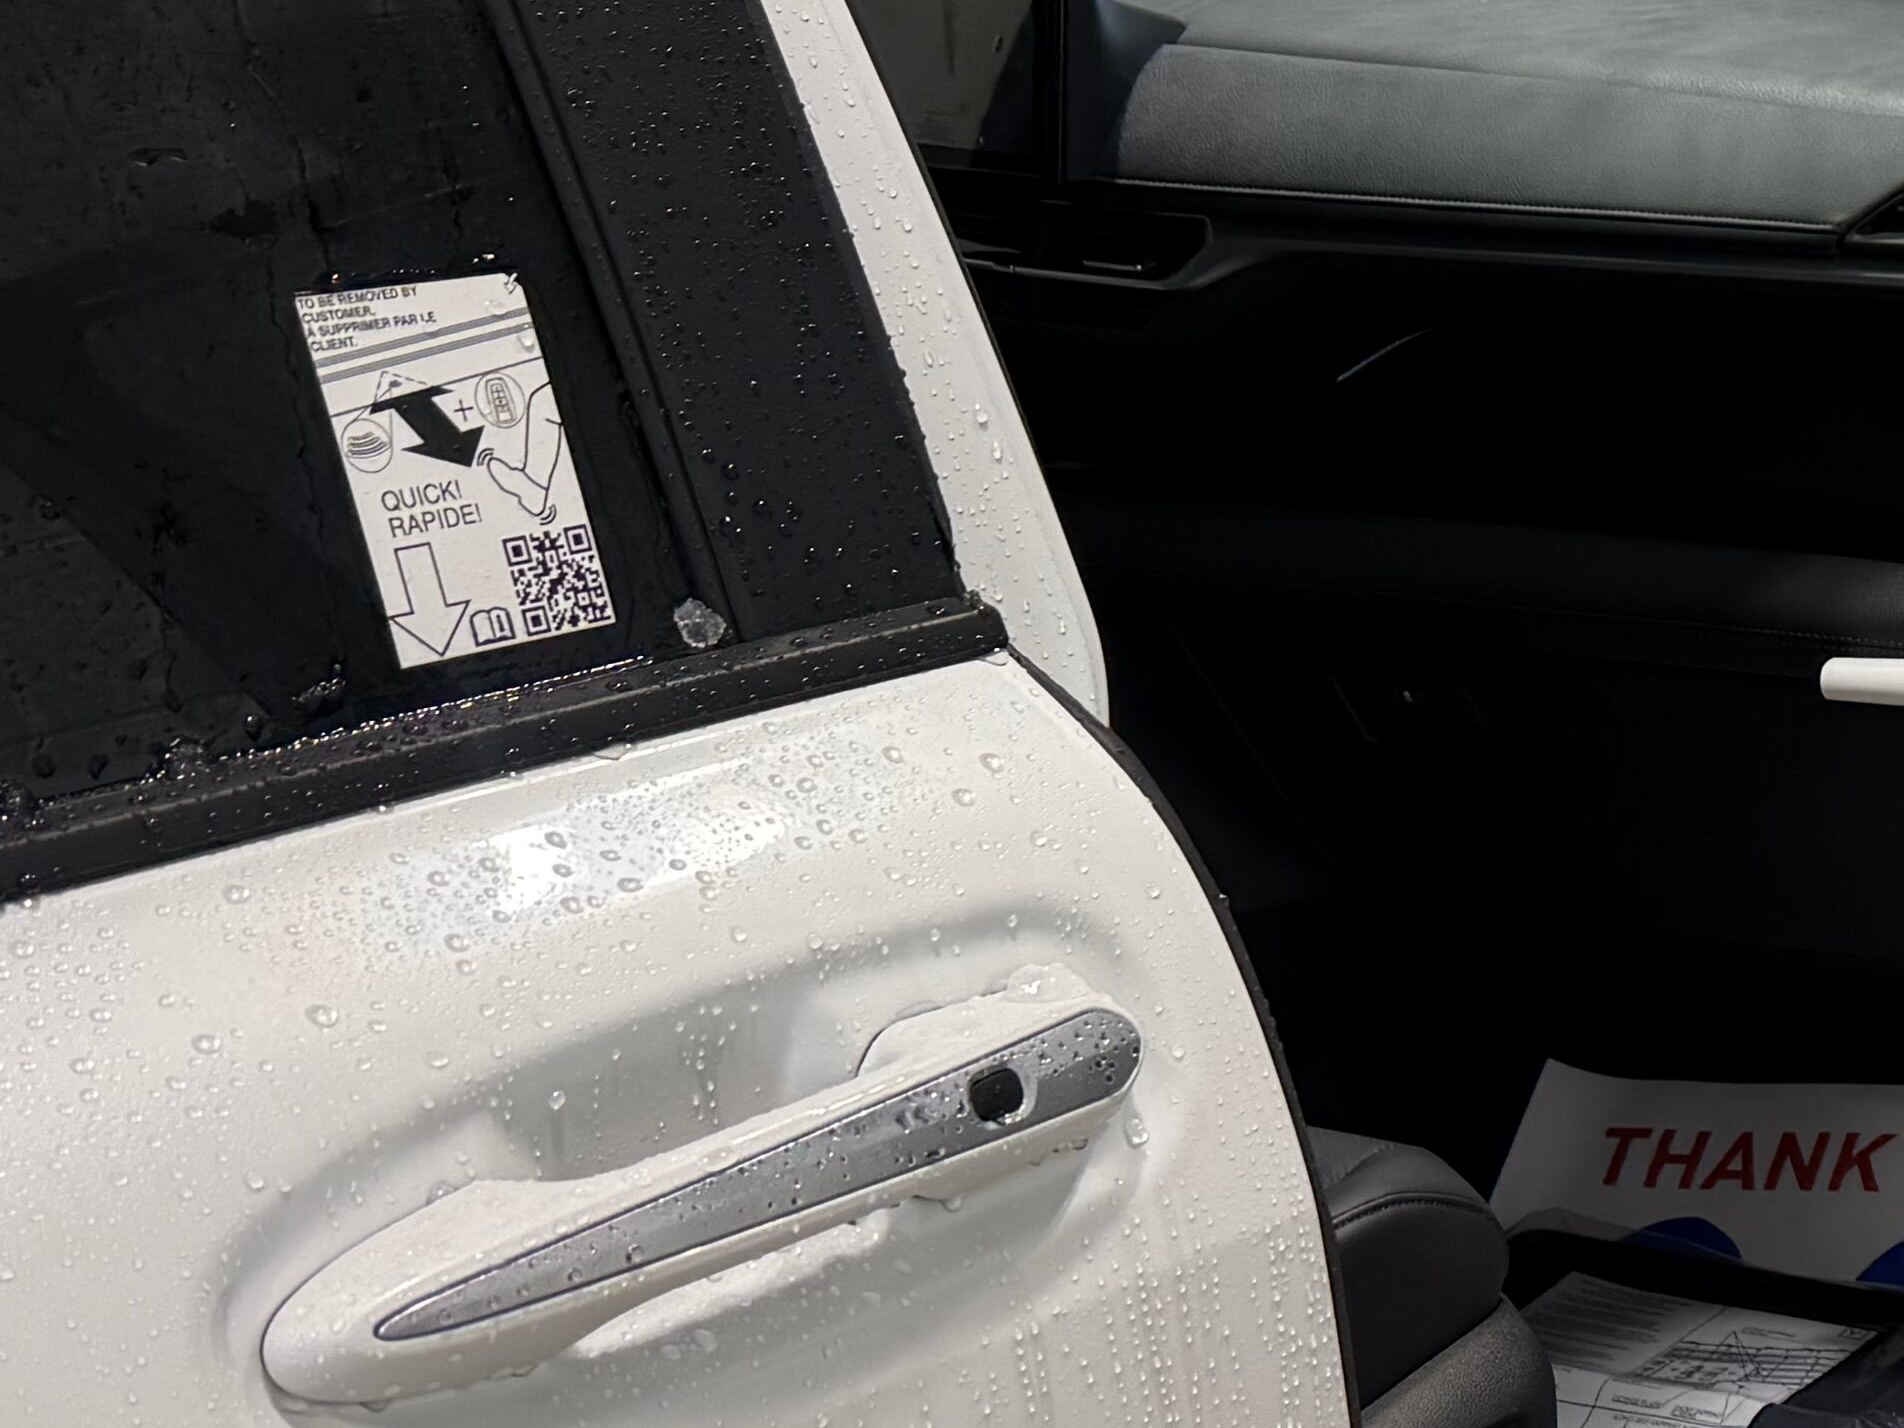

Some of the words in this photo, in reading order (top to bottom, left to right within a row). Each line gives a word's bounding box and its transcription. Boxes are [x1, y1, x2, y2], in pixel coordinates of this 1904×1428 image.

[297, 298, 315, 309] TO
[318, 294, 335, 307] BE
[337, 287, 399, 305] REMOVED
[400, 286, 417, 298] BY
[318, 318, 391, 337] SUPPRIMER
[393, 314, 418, 326] PAR
[380, 478, 463, 512] QUICK!
[388, 502, 483, 538] RAPIDE!
[1601, 1126, 1898, 1194] THANK
